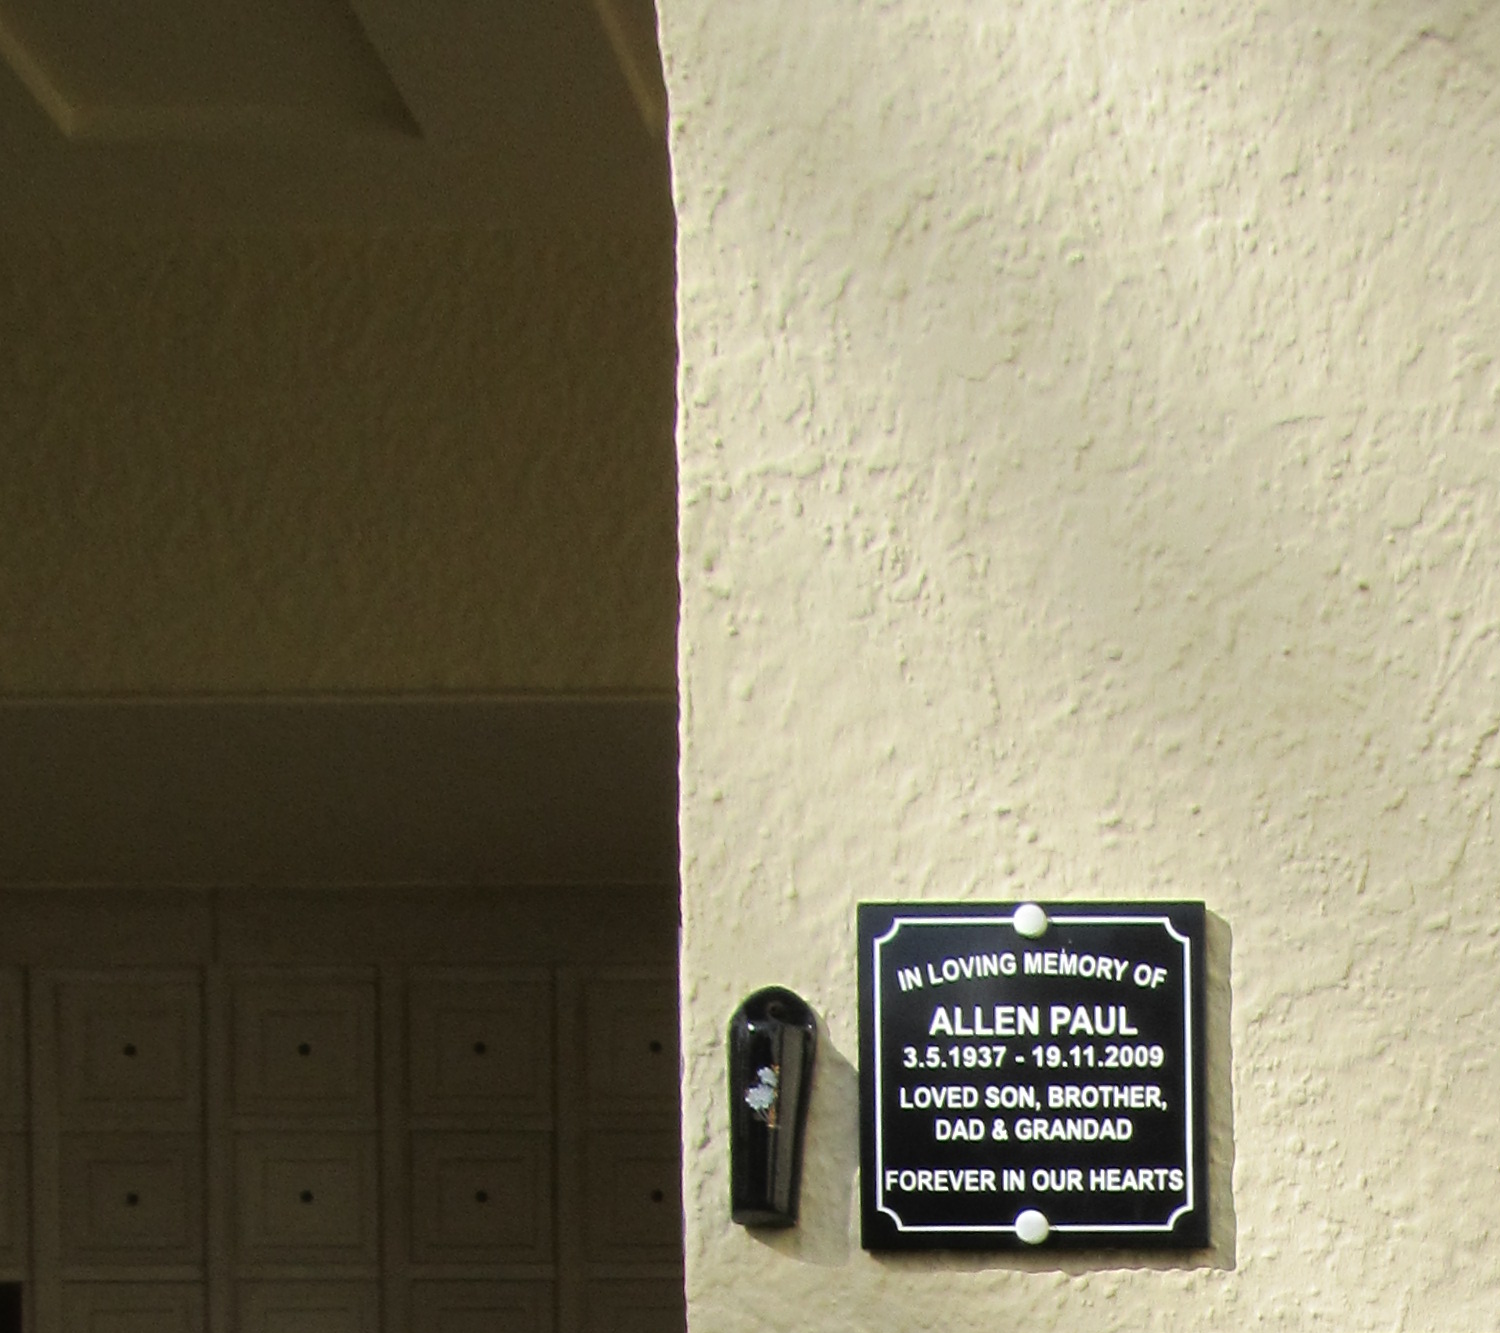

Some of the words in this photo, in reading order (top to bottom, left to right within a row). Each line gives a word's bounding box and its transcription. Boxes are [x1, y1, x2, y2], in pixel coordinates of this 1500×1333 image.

[897, 966, 923, 992] IN
[927, 952, 1017, 985] LOVING
[1023, 948, 1129, 981] MEMORY
[1133, 964, 1167, 989] OF
[929, 1005, 1039, 1036] ALLEN
[1050, 1005, 1138, 1036] PAUL
[903, 1045, 1007, 1068] 3.5.1937
[1032, 1045, 1164, 1068] 19.11.2009
[899, 1086, 979, 1109] LOVED
[984, 1085, 1041, 1111] SON,
[1047, 1085, 1167, 1111] BROTHER,
[935, 1118, 985, 1141] DAD
[991, 1118, 1009, 1141] &
[1014, 1118, 1133, 1141] GRANDAD
